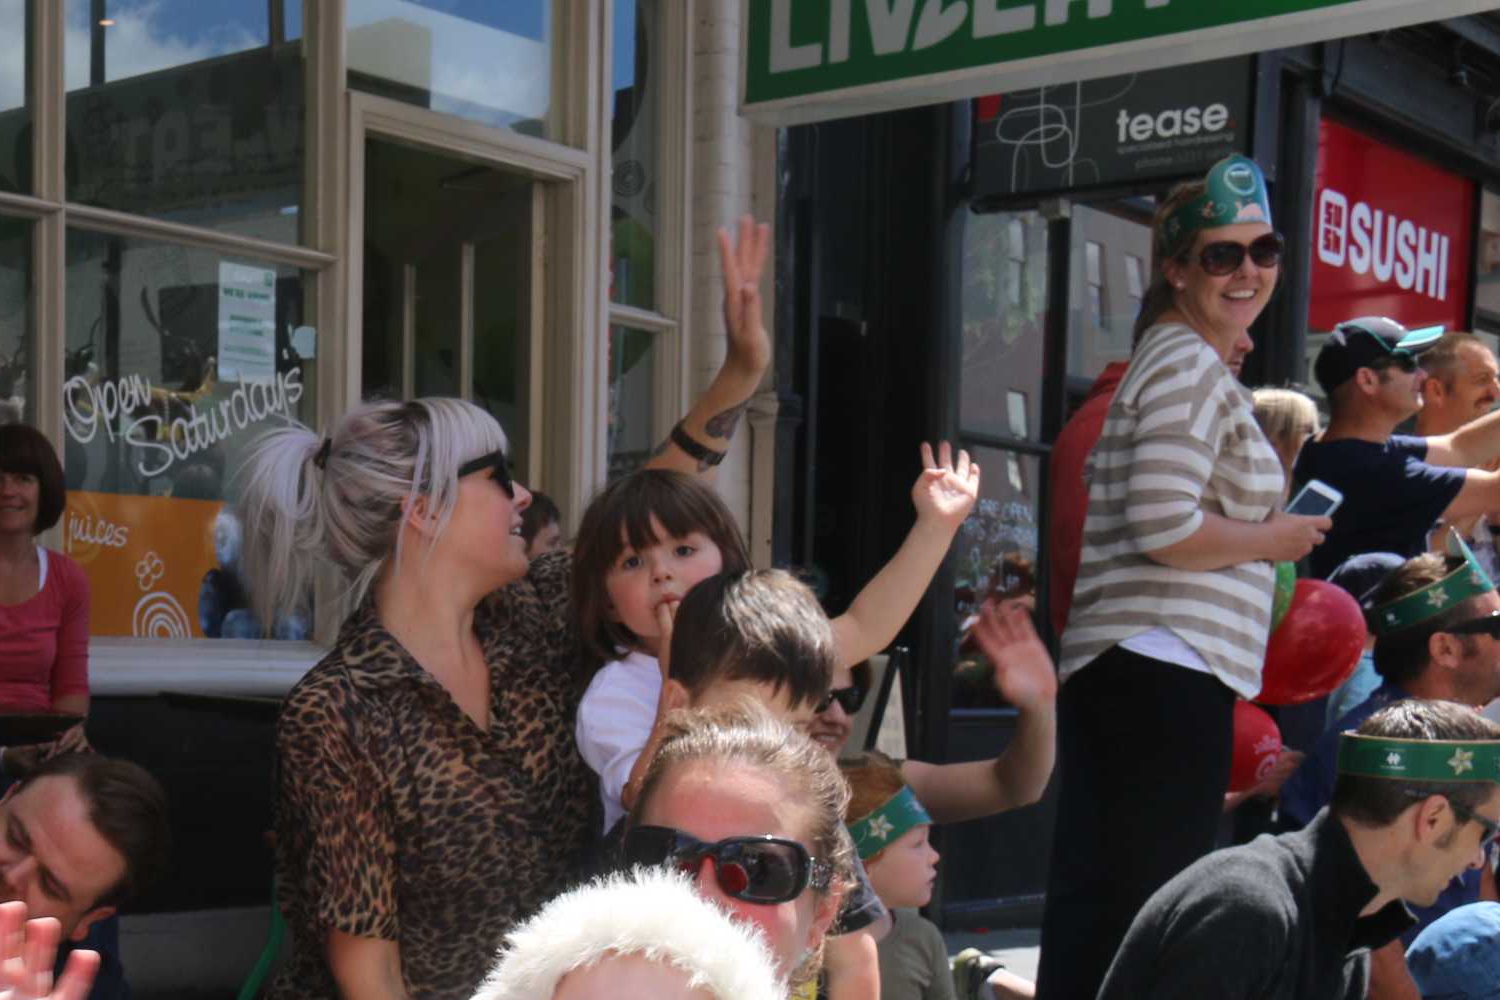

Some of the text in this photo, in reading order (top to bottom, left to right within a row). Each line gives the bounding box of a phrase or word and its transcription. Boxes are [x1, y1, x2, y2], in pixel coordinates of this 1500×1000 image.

[1348, 201, 1450, 302] SUSHI
[62, 372, 151, 445] Open
[125, 366, 304, 478] Saturdays
[67, 511, 131, 554] juices
